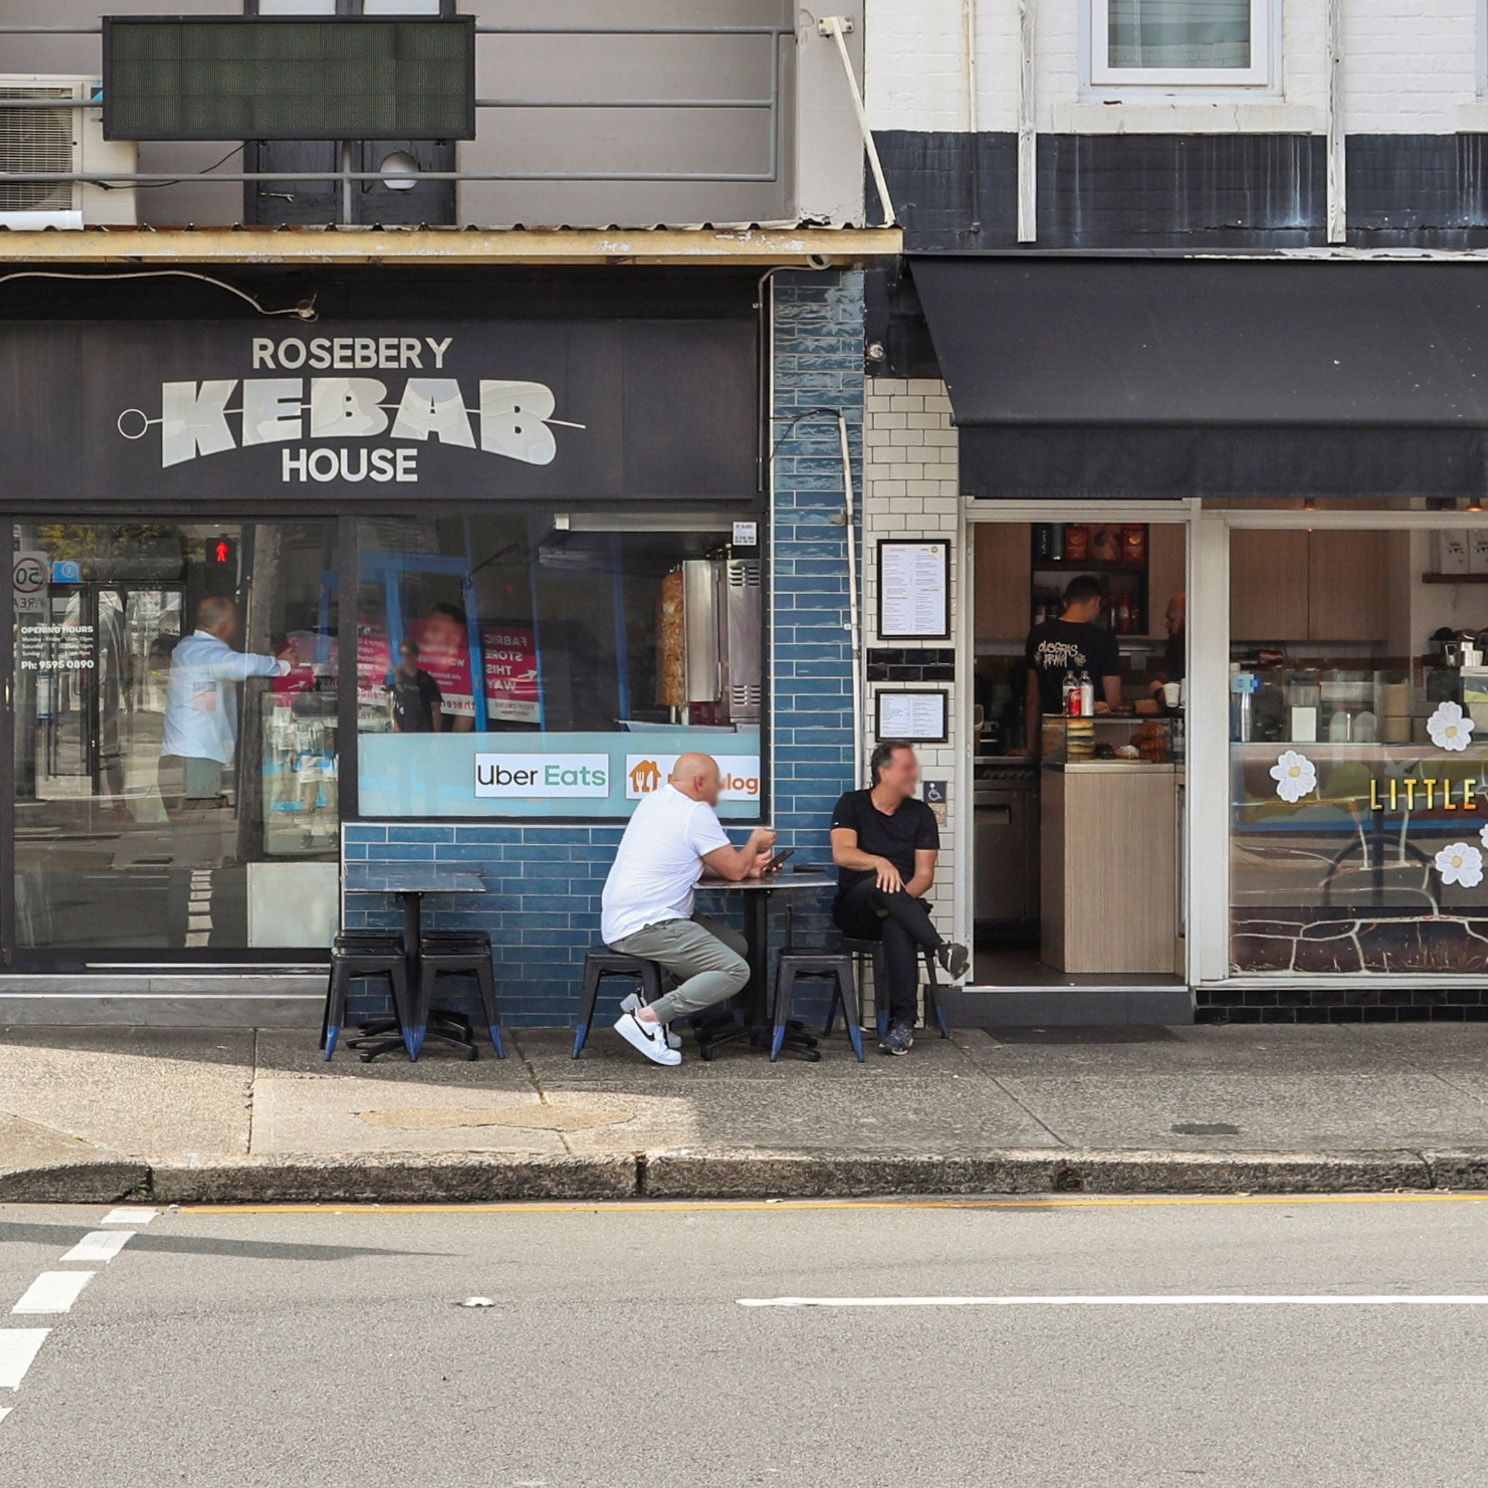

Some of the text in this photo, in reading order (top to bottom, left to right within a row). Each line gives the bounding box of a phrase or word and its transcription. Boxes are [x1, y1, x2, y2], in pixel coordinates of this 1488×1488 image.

[251, 337, 453, 369] ROSEBERY
[162, 376, 557, 469] KEBAB
[282, 447, 418, 482] HOUSE
[20, 625, 94, 634] OPENING HOURS
[21, 659, 95, 670] Ph: 9595 0890
[477, 764, 607, 786] Uber Eats
[1370, 778, 1478, 811] LITTLE
